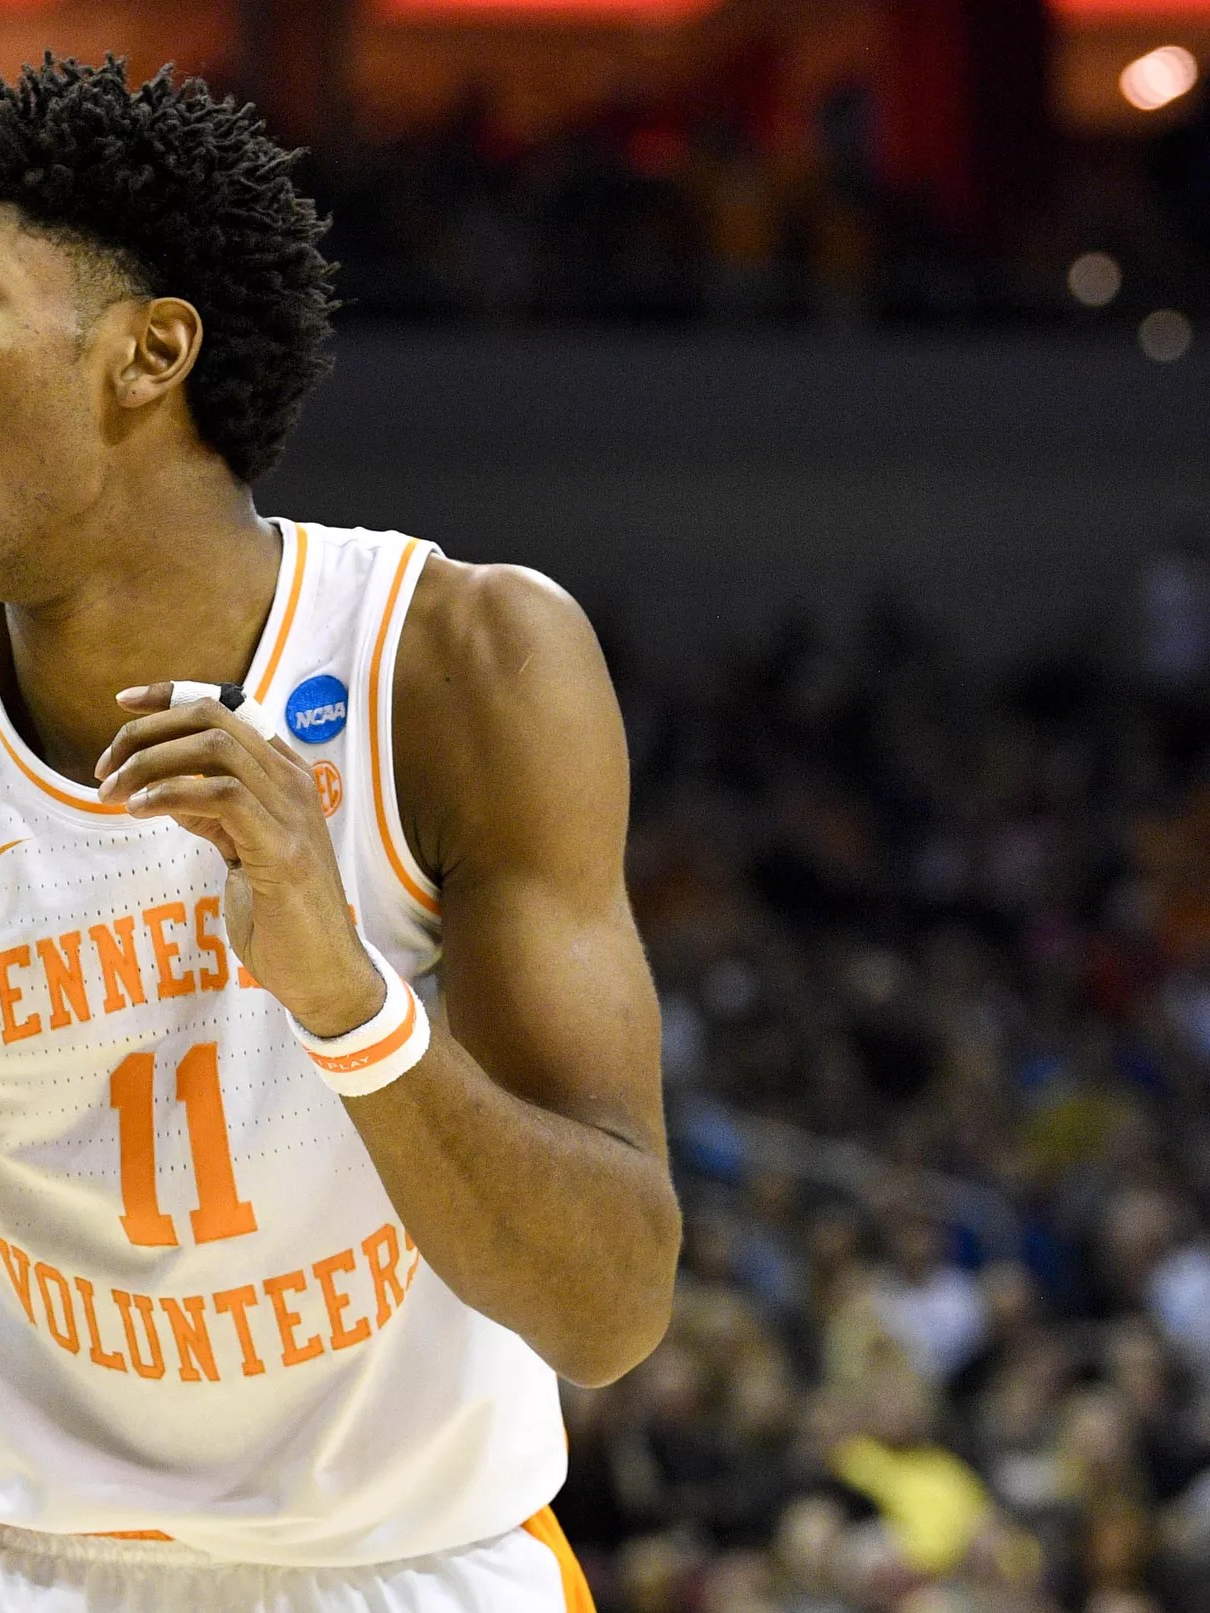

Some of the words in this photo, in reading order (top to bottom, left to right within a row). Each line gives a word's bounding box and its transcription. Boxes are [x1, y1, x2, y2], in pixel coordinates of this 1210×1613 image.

[295, 701, 346, 730] NCAA
[313, 766, 339, 812] EC
[326, 1055, 370, 1071] PLAY
[109, 1041, 258, 1247] 11
